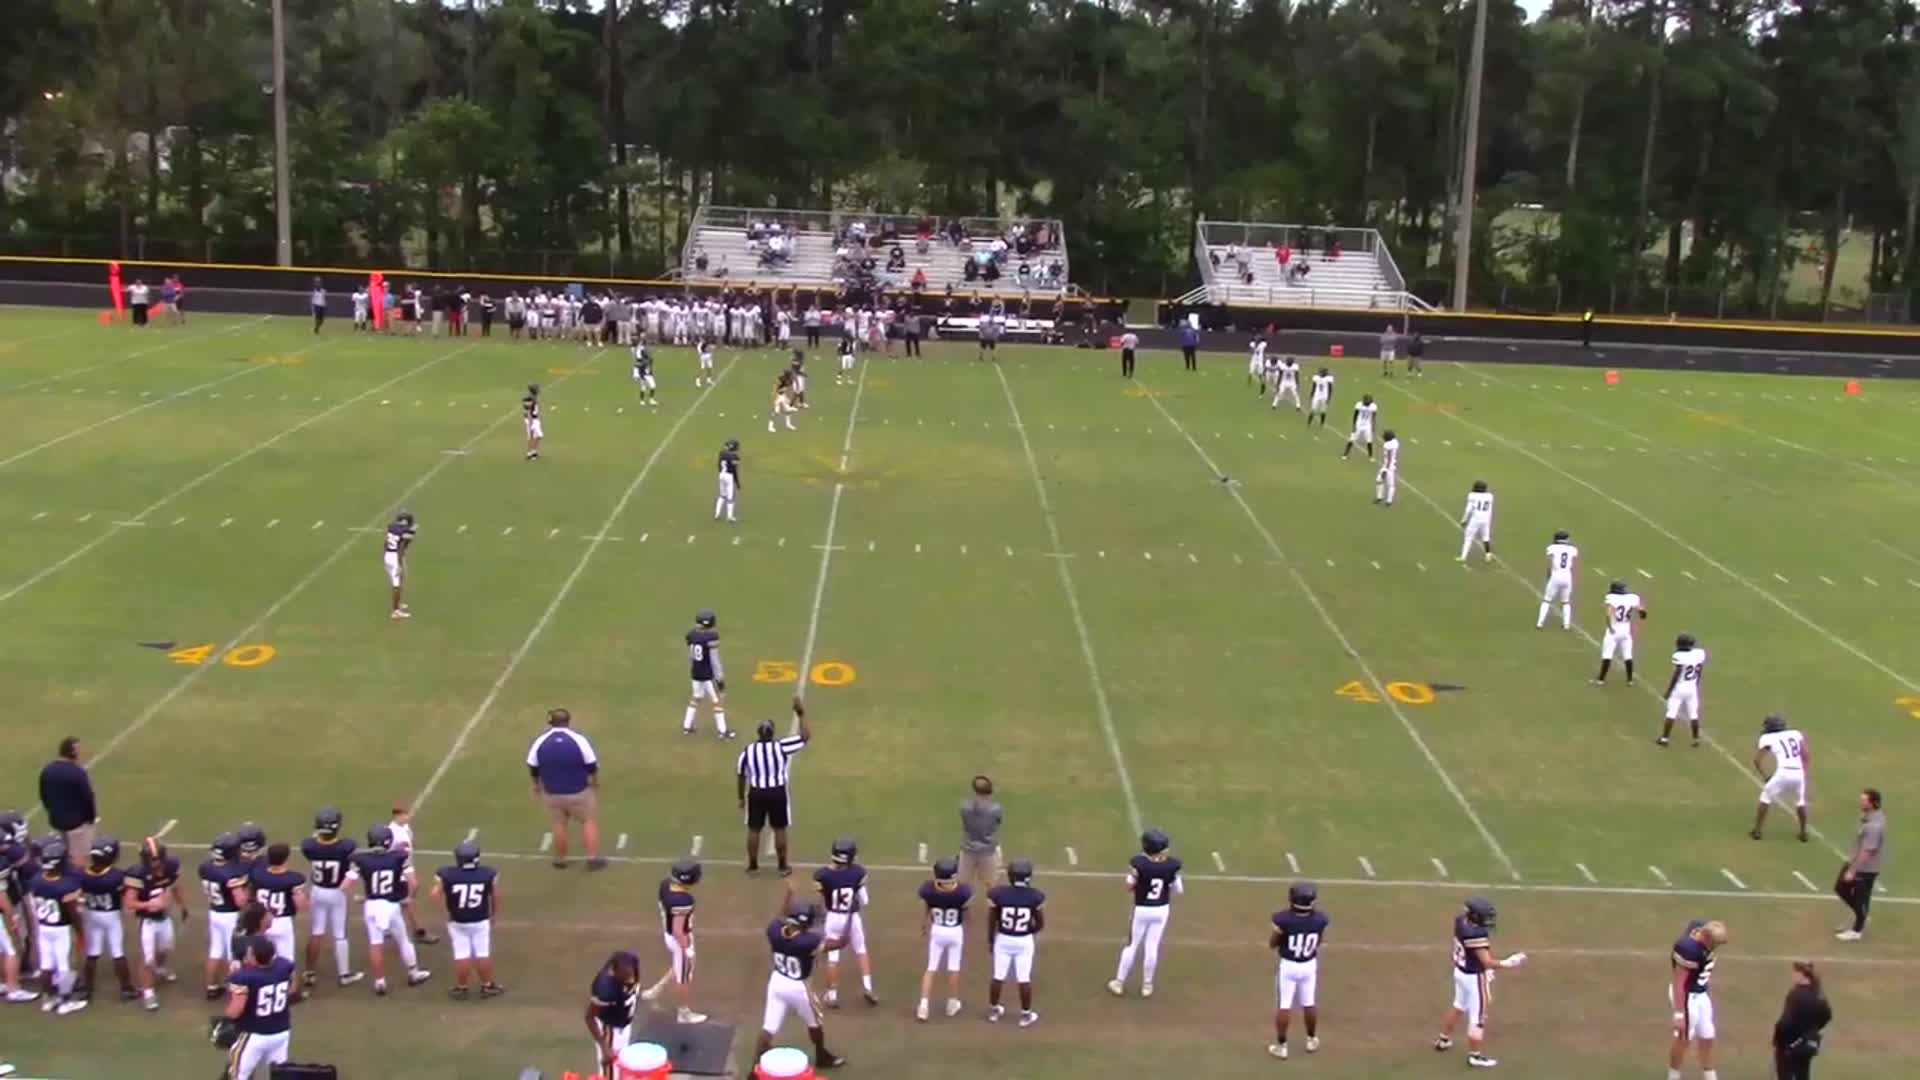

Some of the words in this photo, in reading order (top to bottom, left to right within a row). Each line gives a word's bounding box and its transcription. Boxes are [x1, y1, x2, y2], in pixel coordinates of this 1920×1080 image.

[1559, 552, 1569, 569] 8
[168, 643, 276, 666] 40
[751, 660, 856, 685] 50
[1333, 680, 1435, 704] 40
[371, 869, 394, 895] 12
[1146, 878, 1164, 900] 3
[452, 883, 485, 909] 75
[831, 887, 855, 912] 13
[1000, 907, 1033, 932] 52
[1287, 933, 1319, 957] 40
[256, 981, 289, 1017] 56
